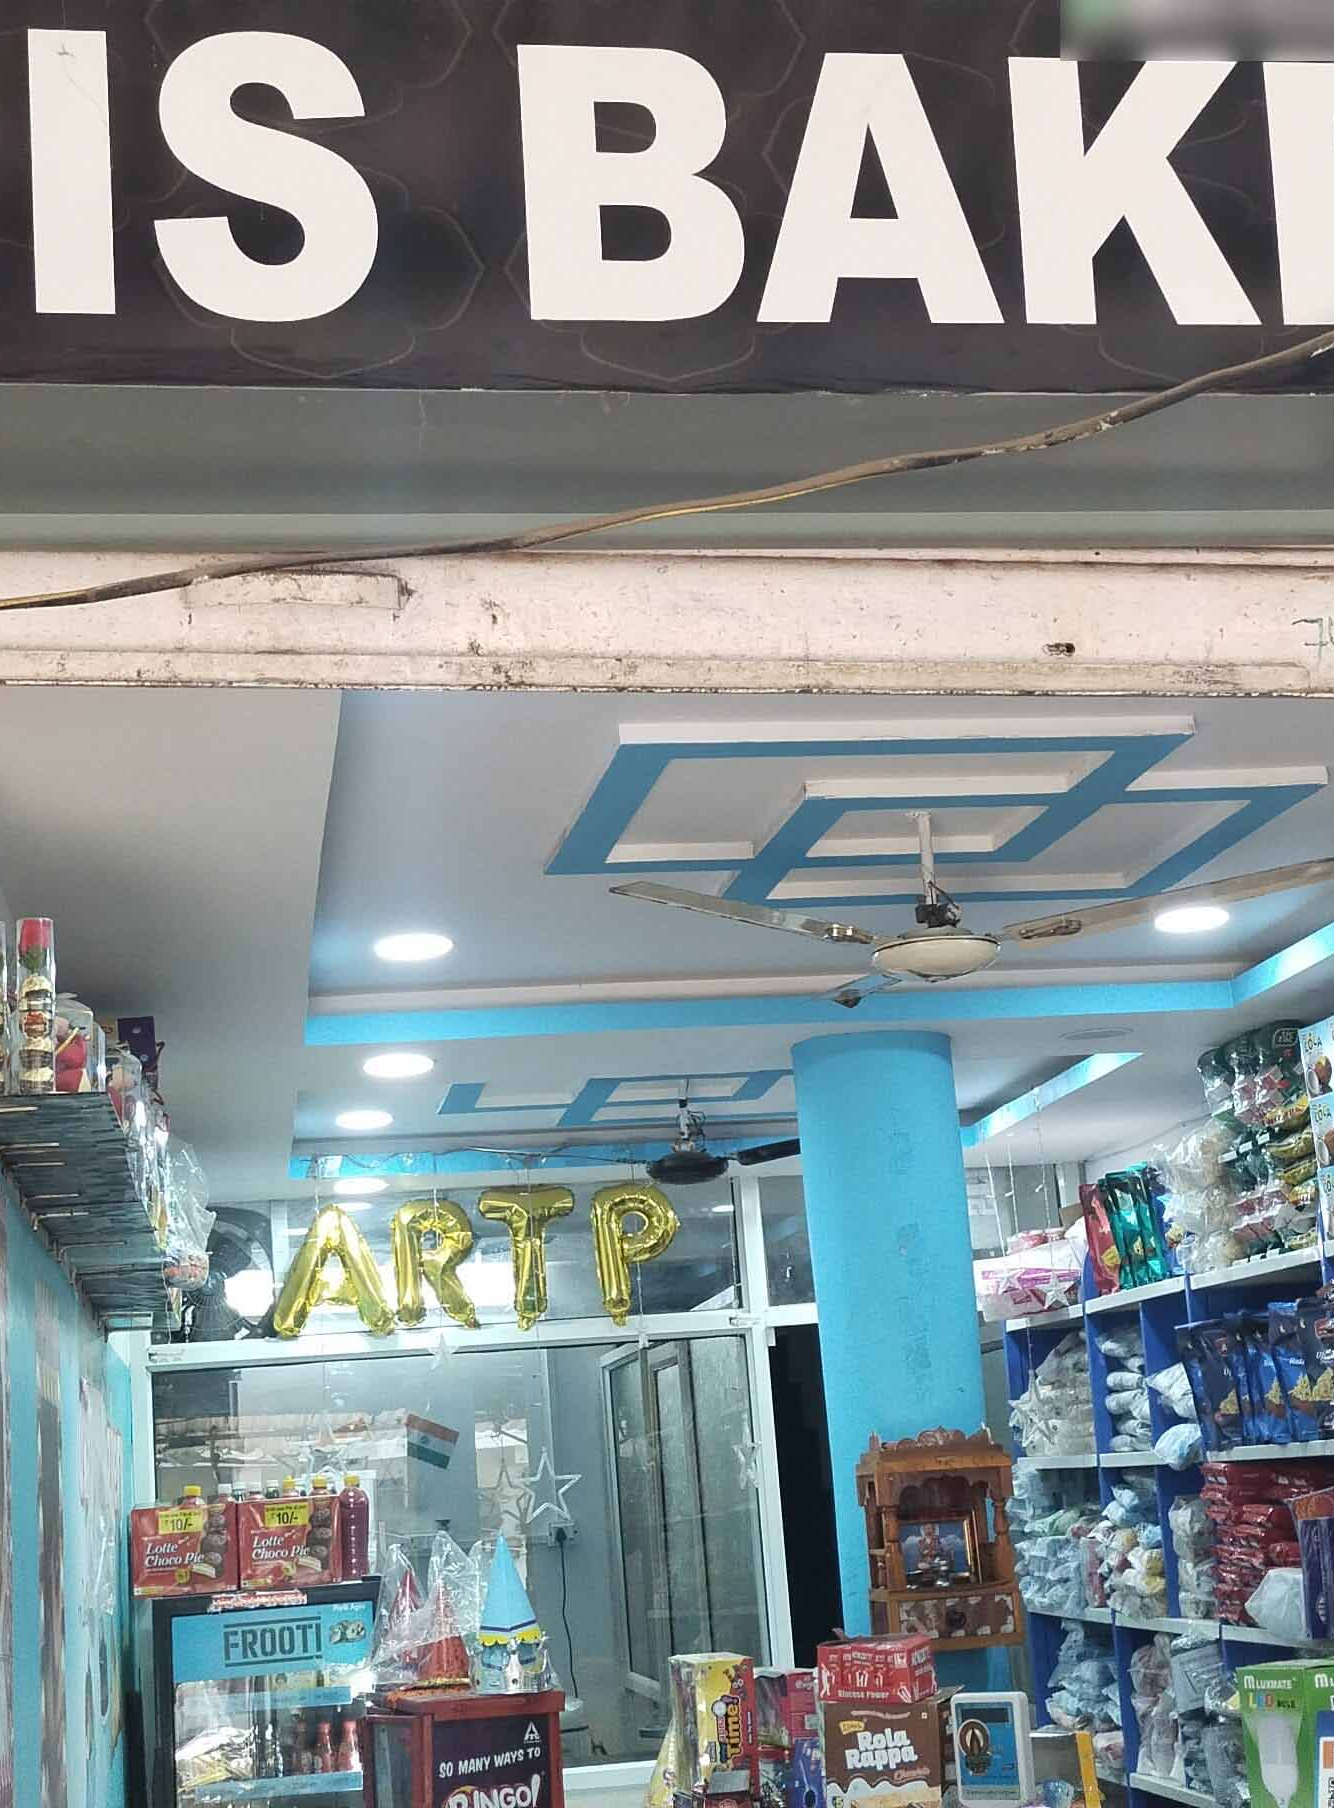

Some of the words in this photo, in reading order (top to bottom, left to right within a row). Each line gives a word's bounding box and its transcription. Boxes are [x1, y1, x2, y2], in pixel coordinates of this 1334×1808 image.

[146, 1542, 179, 1556] Lotte
[252, 1536, 284, 1550] Lotte
[252, 1547, 289, 1560] Choco
[290, 1545, 311, 1557] Pie
[145, 1554, 183, 1568] Choco
[185, 1551, 205, 1564] Pie
[223, 1622, 323, 1661] FROOTI
[857, 1728, 911, 1751] Rola
[439, 1761, 454, 1778] SO
[458, 1756, 491, 1775] MANY
[494, 1749, 524, 1767] WAYS
[527, 1747, 541, 1759] TO
[845, 1746, 919, 1771] Rappa
